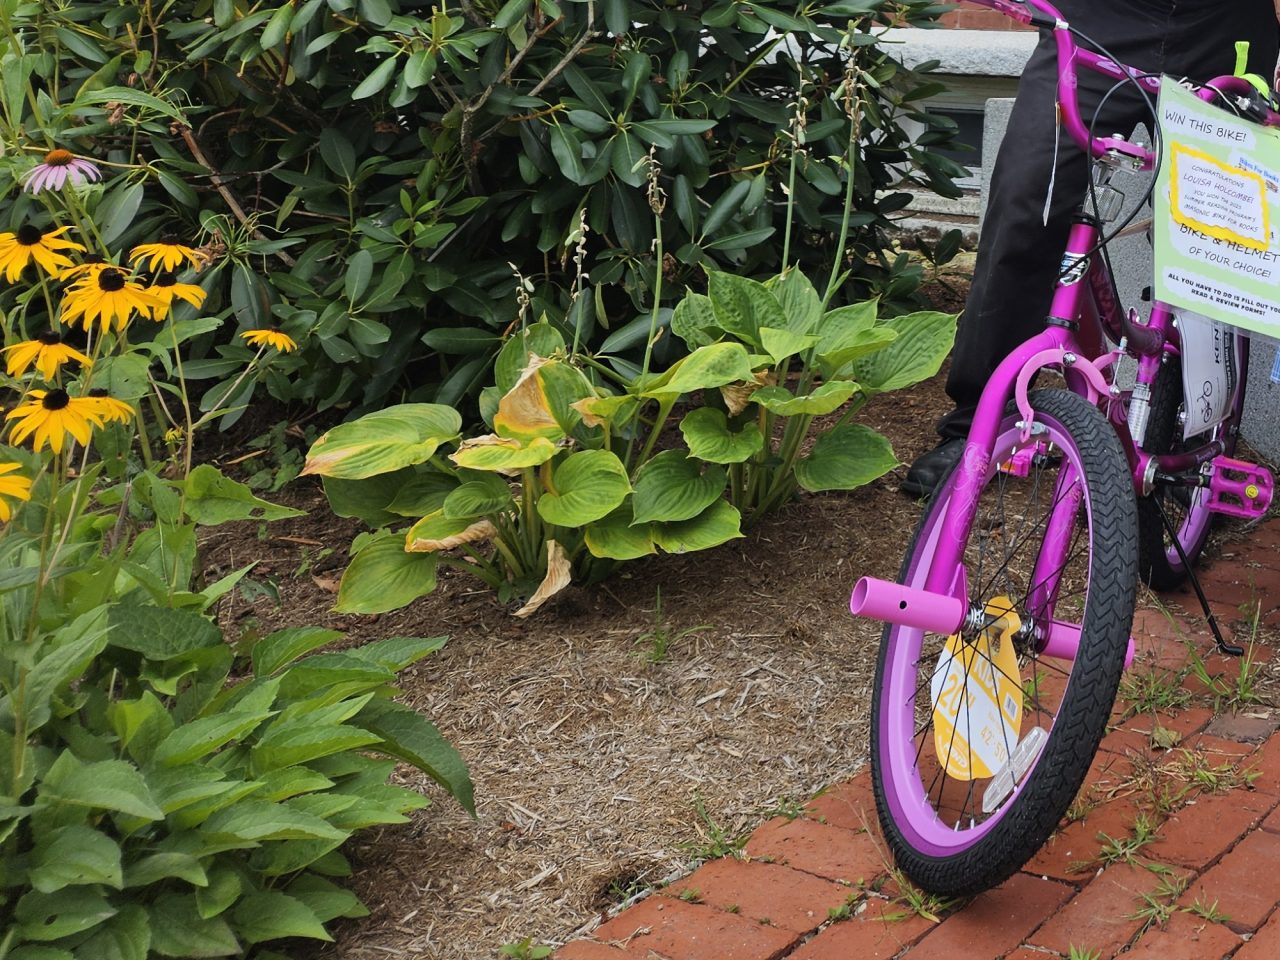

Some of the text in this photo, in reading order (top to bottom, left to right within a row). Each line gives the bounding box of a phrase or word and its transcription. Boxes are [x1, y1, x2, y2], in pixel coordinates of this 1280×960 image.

[1165, 109, 1247, 143] WIN THIS BIKE!
[1183, 173, 1255, 204] LOUISA HOLCOMBE!
[1180, 222, 1208, 240] BIKE
[1189, 246, 1272, 279] OF YOUR CHOICE!
[1168, 272, 1180, 281] ALL
[1181, 278, 1194, 287] YOU
[1195, 282, 1212, 292] HAVE
[1213, 288, 1222, 296] TO
[1222, 291, 1232, 299] DO
[1233, 294, 1240, 302] IS
[1241, 297, 1255, 306] FILL
[1255, 301, 1268, 310] OUT
[1191, 288, 1208, 298] READ
[1215, 296, 1240, 309] REVIEW
